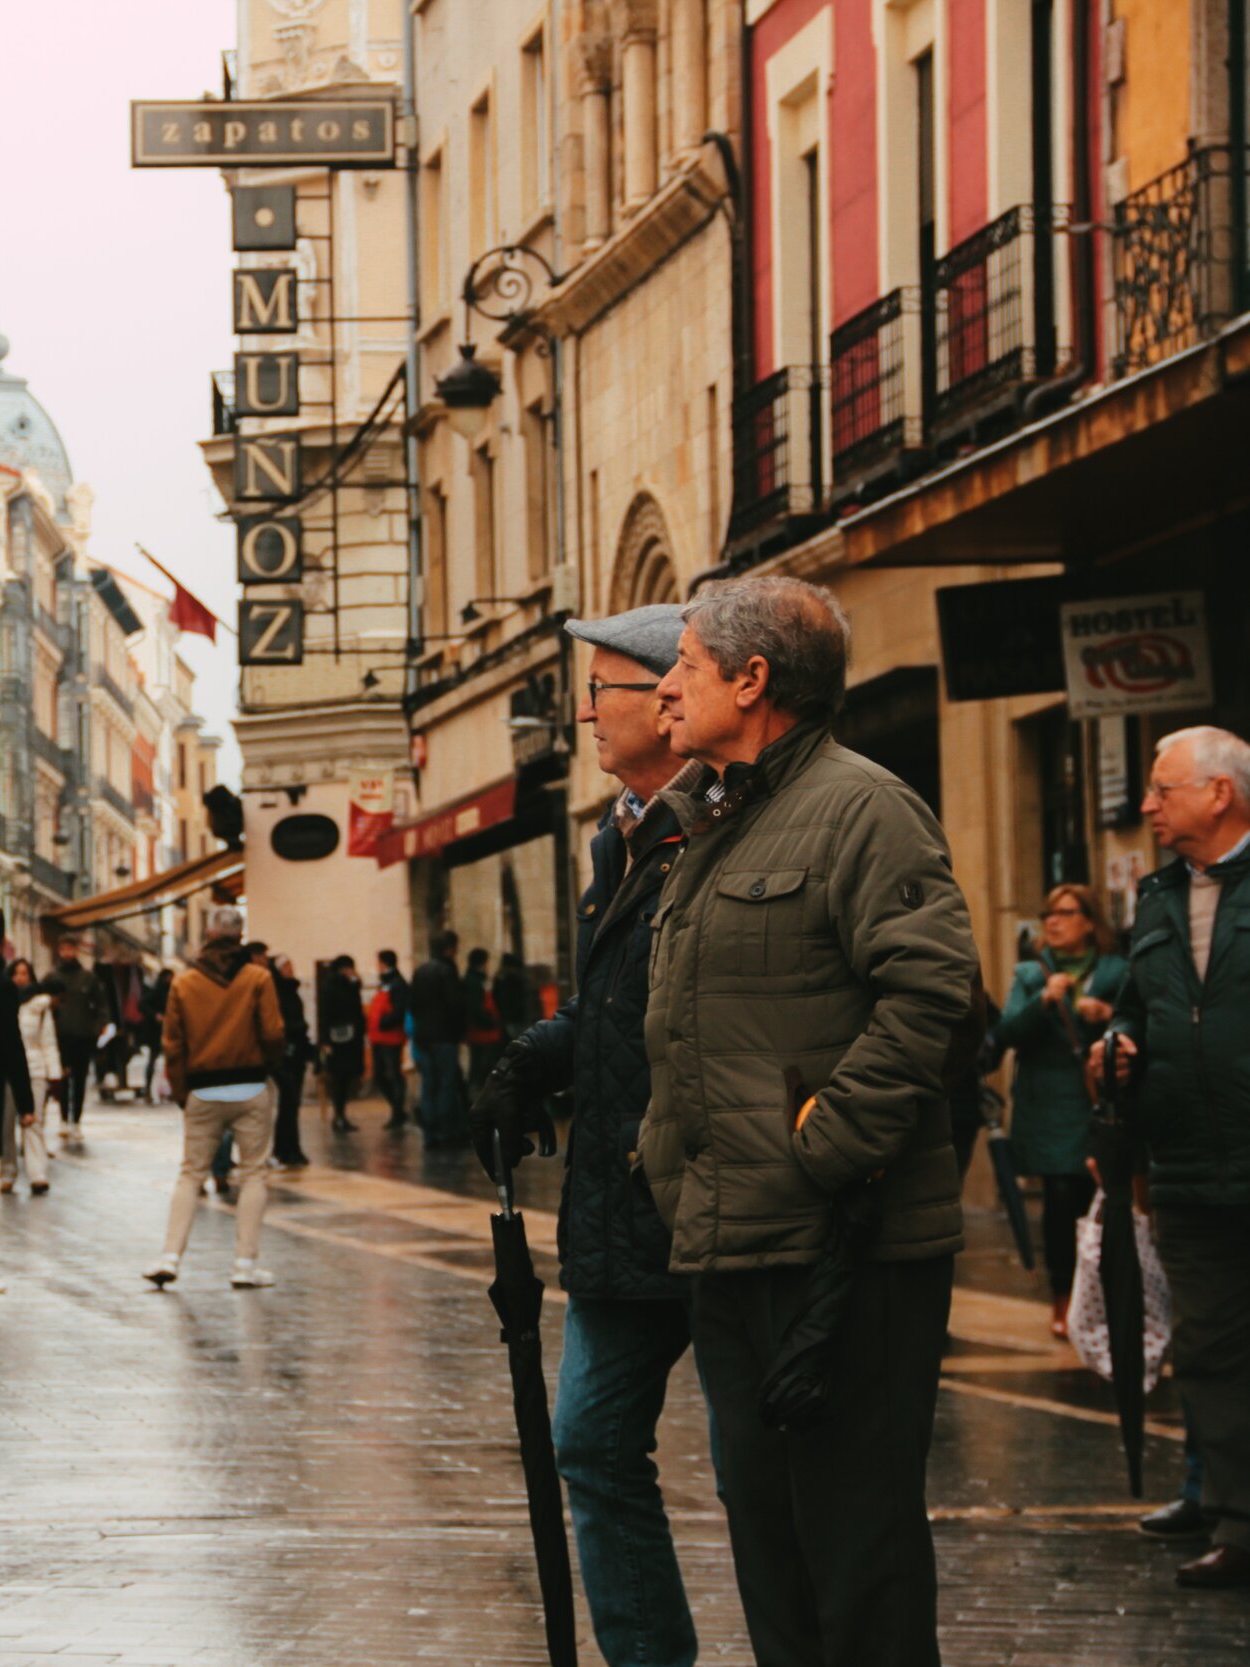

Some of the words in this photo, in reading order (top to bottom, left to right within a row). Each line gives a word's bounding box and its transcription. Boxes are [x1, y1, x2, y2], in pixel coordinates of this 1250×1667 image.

[161, 118, 371, 148] zapatos
[237, 274, 298, 660] MUÑOZ
[1070, 597, 1199, 637] HOSTEL
